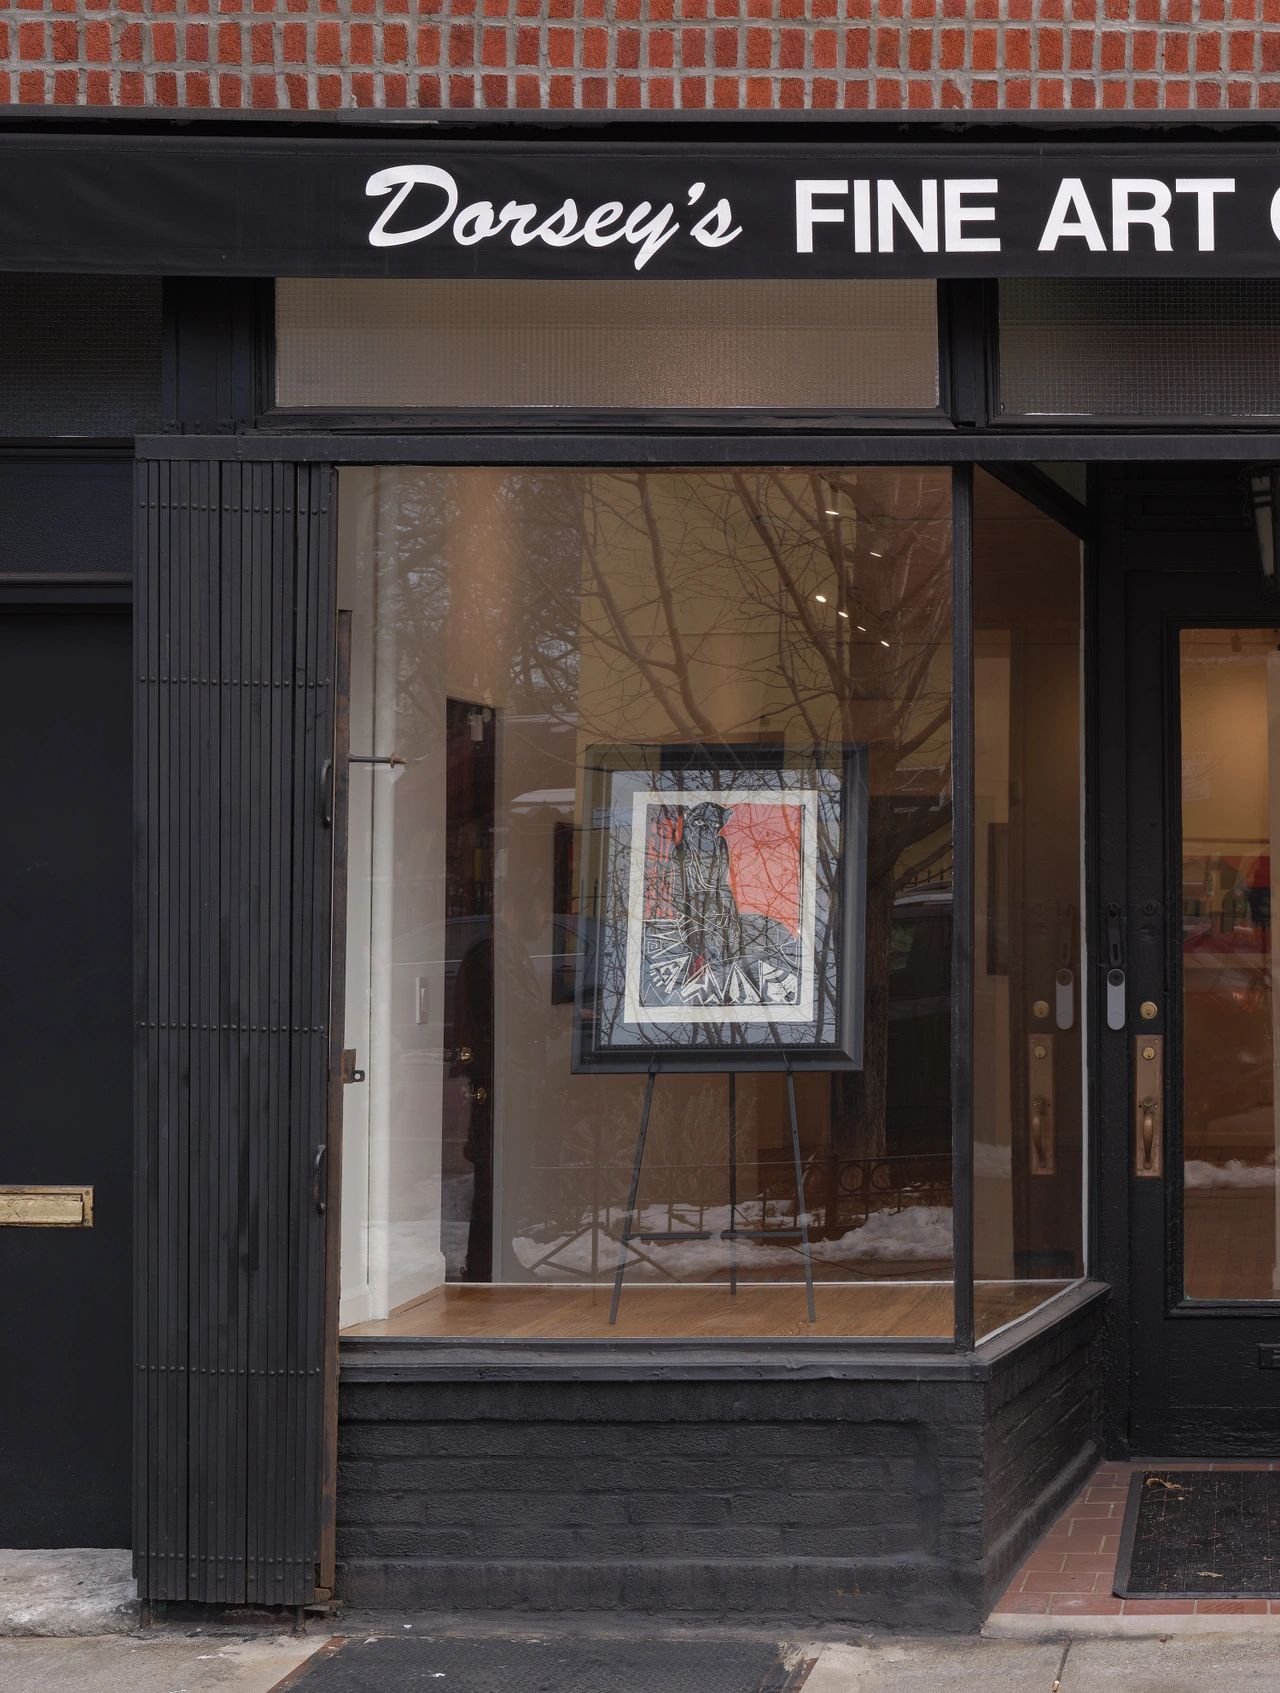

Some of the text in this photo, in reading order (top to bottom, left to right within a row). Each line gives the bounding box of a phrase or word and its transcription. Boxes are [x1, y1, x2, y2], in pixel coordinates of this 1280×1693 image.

[365, 164, 743, 271] Dorsey's
[795, 178, 1002, 253] FINE
[1037, 177, 1237, 252] ART
